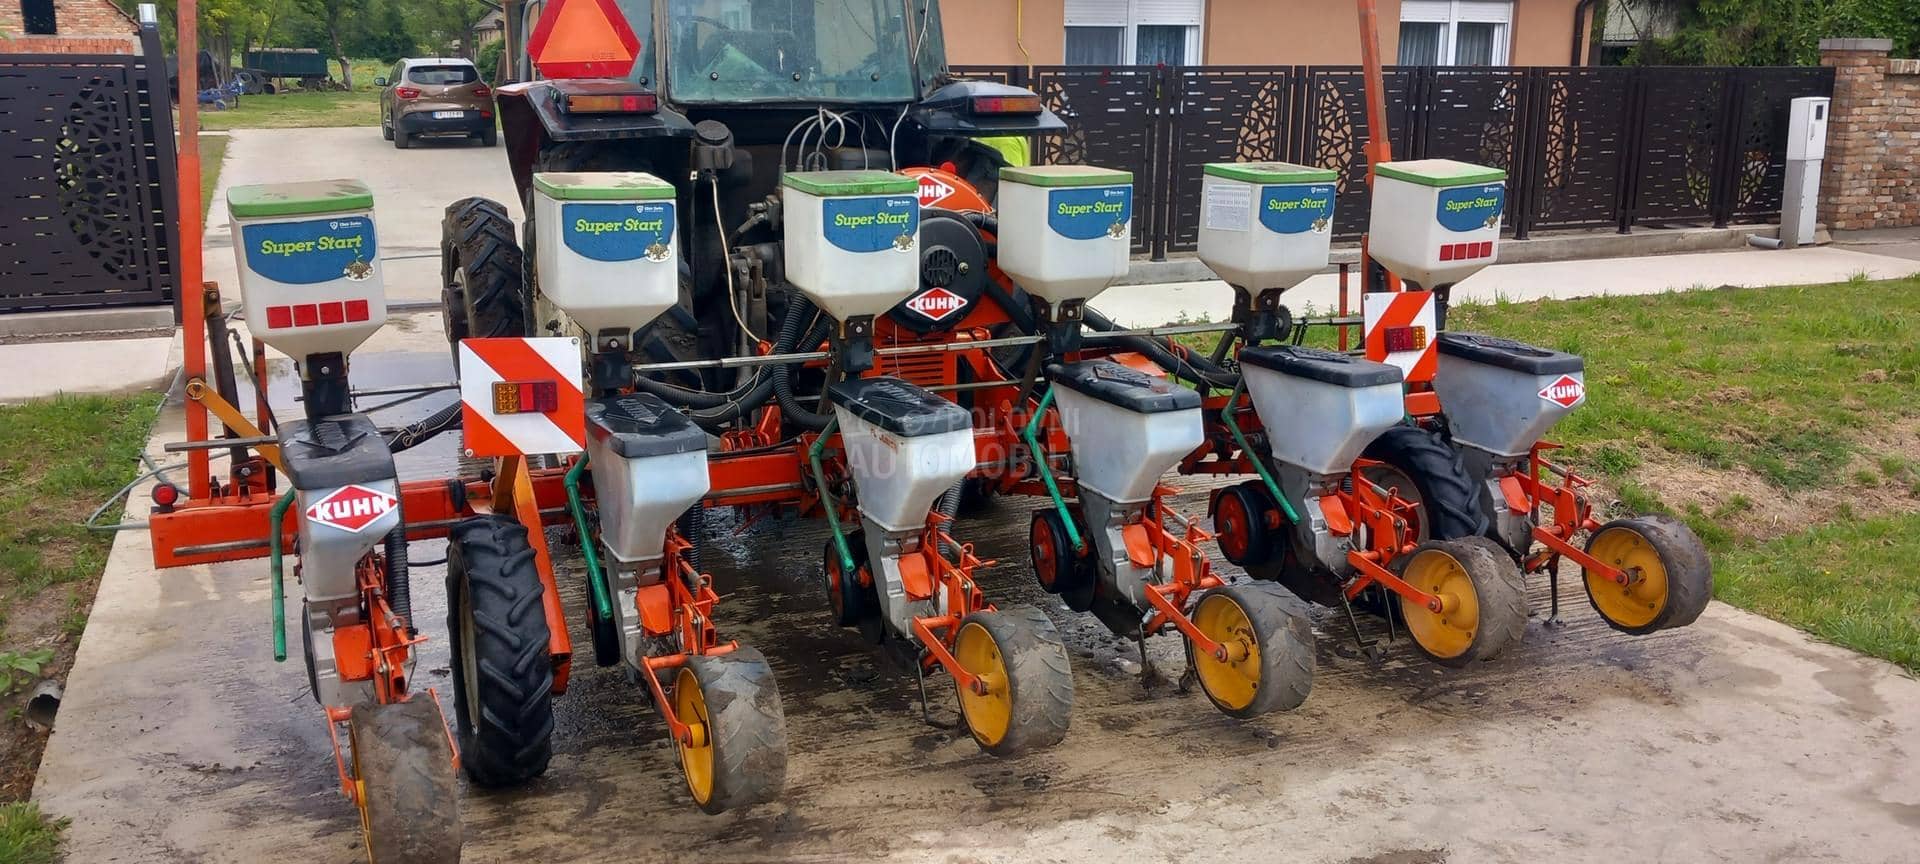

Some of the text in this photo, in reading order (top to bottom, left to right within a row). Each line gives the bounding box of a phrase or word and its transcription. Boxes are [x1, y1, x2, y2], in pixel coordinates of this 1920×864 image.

[919, 185, 946, 197] HN
[1057, 201, 1123, 217] Super Start
[1268, 198, 1327, 212] Super Start
[1446, 197, 1497, 212] Super Start
[575, 218, 663, 235] Super Start
[835, 212, 910, 228] Super Start
[261, 234, 362, 256] Super Start
[914, 296, 959, 310] KUHN
[1546, 384, 1583, 399] KUHN
[315, 495, 391, 521] KUHN
